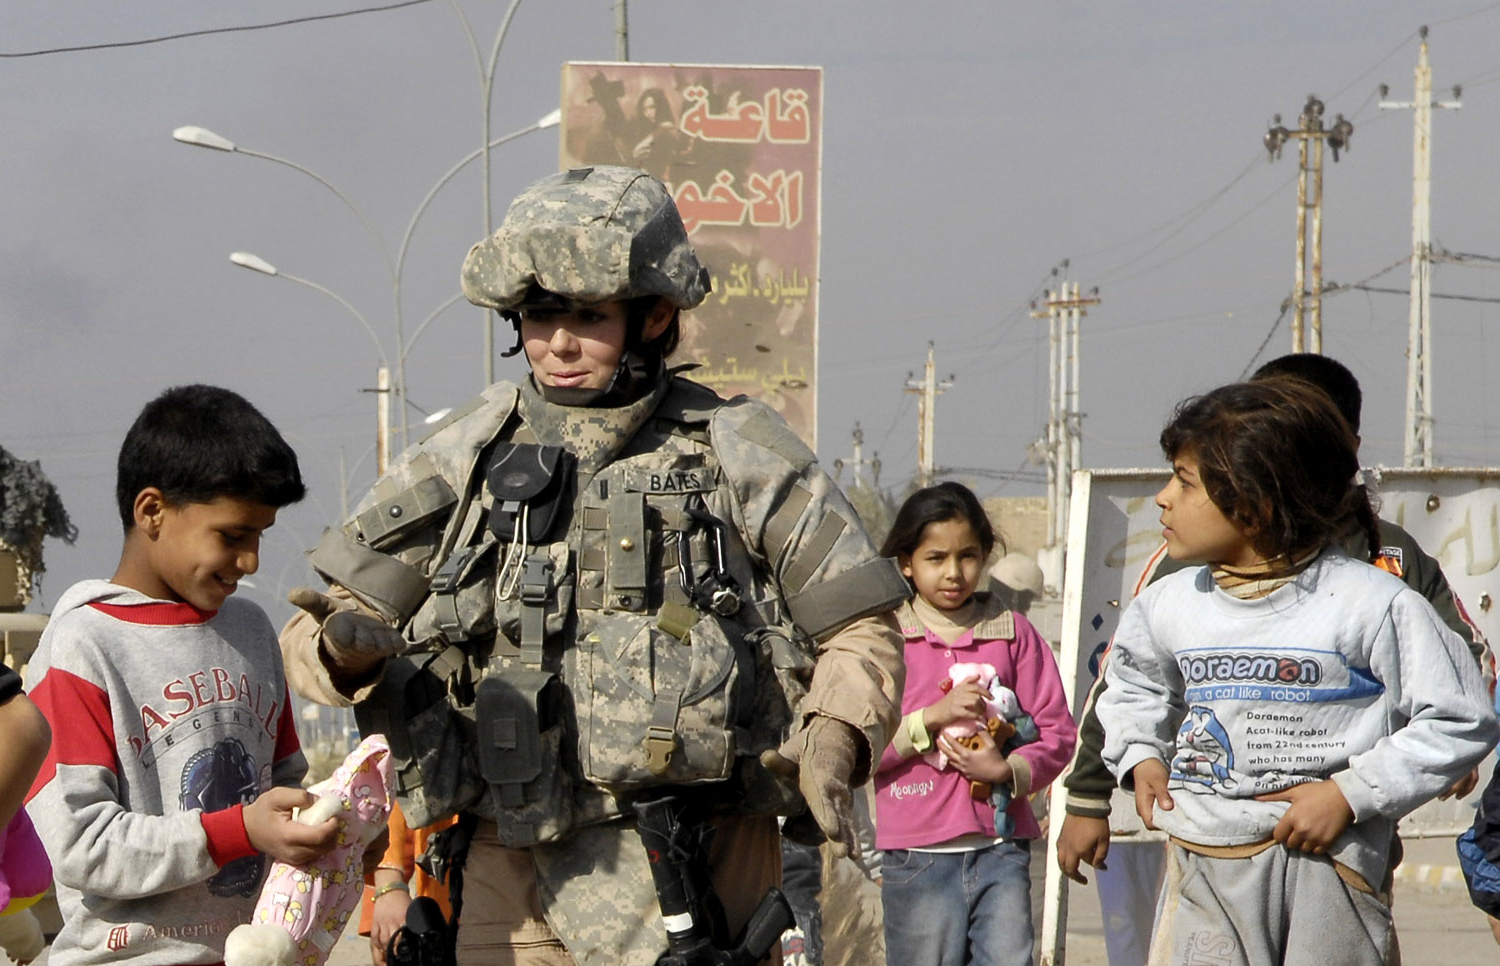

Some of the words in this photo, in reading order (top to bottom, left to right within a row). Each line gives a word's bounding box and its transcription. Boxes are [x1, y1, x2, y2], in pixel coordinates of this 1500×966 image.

[680, 86, 811, 143] قاعة
[667, 169, 804, 236] الاخو
[650, 472, 701, 491] BATES
[1215, 687, 1235, 699] cat
[1238, 687, 1262, 699] like
[1246, 711, 1303, 722] Doraemon
[1299, 728, 1328, 736] robot
[1247, 741, 1273, 750] from
[1275, 740, 1302, 749] 22nd
[1249, 755, 1270, 765] who
[1273, 755, 1292, 763] has
[1295, 755, 1326, 764] many
